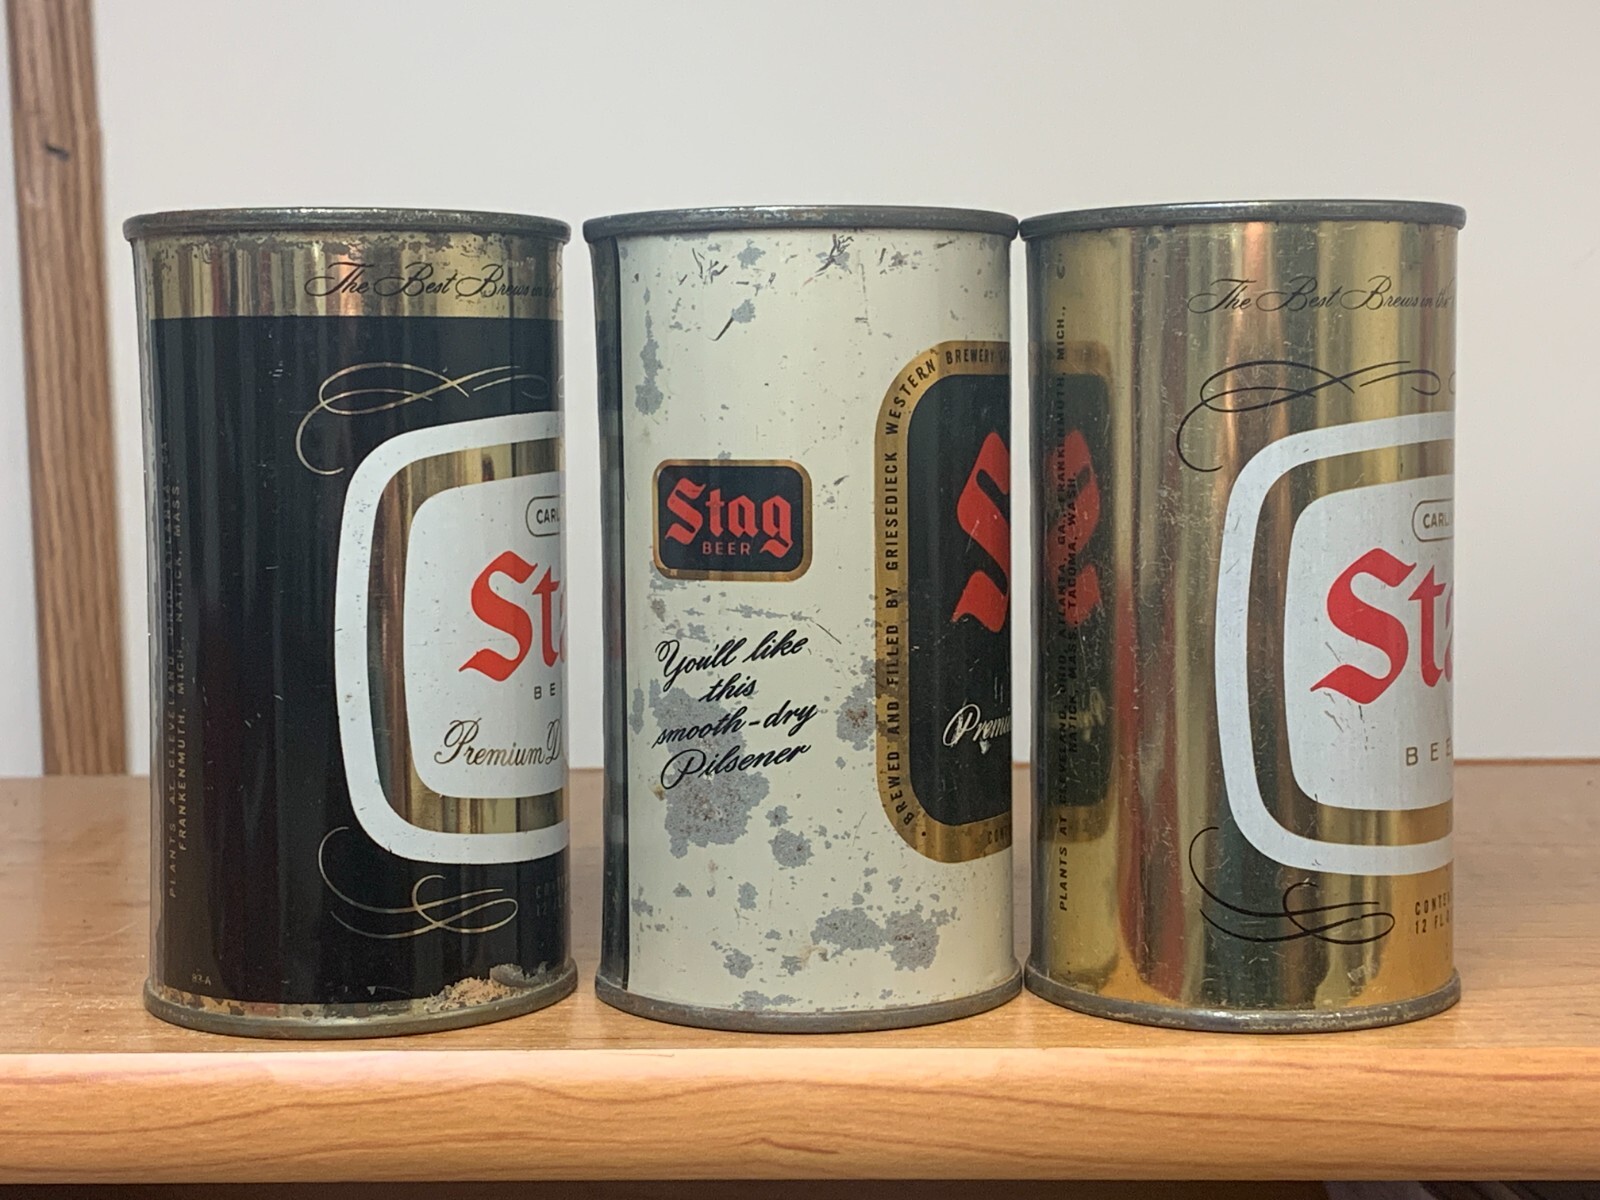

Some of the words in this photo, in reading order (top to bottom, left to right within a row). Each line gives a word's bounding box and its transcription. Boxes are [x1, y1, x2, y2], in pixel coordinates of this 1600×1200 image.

[304, 261, 374, 297] The
[373, 261, 457, 297] Best
[456, 263, 529, 298] Brews
[1187, 278, 1257, 314] The
[1256, 275, 1342, 312] Best
[1340, 275, 1419, 311] Brews
[945, 349, 994, 365] BREWERY
[1056, 306, 1066, 361] MICH.,
[885, 359, 936, 435] WESTERN
[664, 477, 793, 558] Stag
[885, 452, 898, 570] GRIESEDIECK
[1067, 472, 1077, 526] WASH.
[702, 541, 750, 556] BEER
[1067, 536, 1077, 609] TACOMA,
[886, 587, 898, 608] BY
[655, 637, 748, 692] You'll
[742, 628, 809, 662] like
[886, 625, 899, 687] FILLED
[698, 673, 757, 702] this
[434, 717, 546, 766] Premium
[887, 701, 900, 735] AND
[660, 745, 811, 790] Pilsener
[888, 752, 915, 826] BREWED
[168, 781, 176, 805] AT
[1058, 815, 1067, 836] AT
[168, 822, 177, 898] PLANTS
[1058, 846, 1068, 912] PLANTS
[1415, 919, 1427, 934] 12
